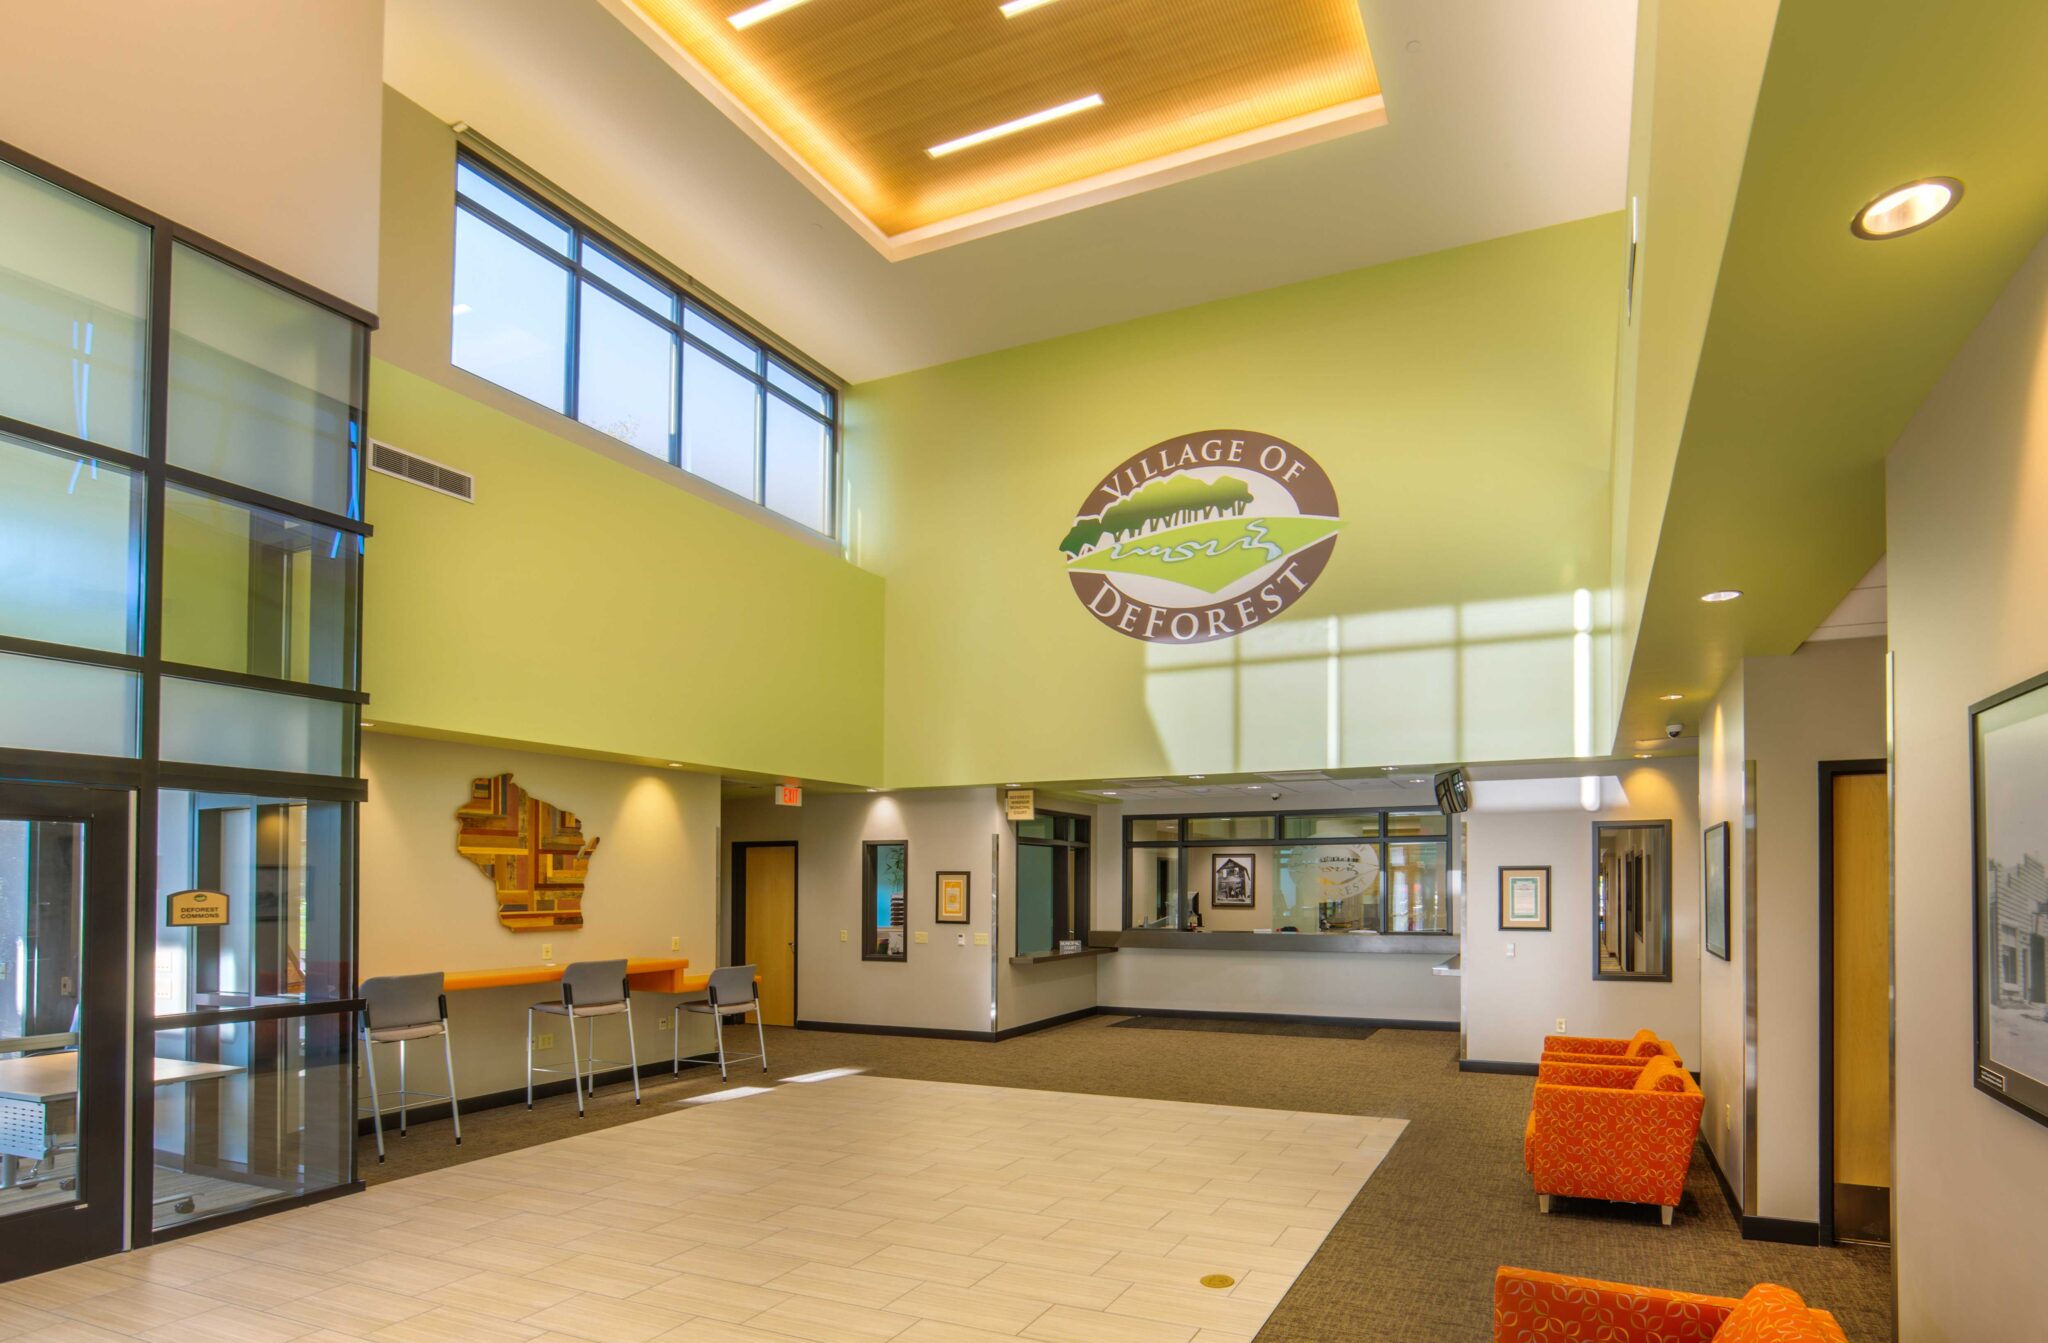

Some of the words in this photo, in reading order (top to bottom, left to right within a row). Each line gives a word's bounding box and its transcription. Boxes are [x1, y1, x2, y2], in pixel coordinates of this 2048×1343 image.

[1100, 439, 1245, 499] VILLAGE
[1260, 445, 1305, 484] OF
[1087, 561, 1308, 641] DEFOREST
[783, 787, 799, 804] EXIT
